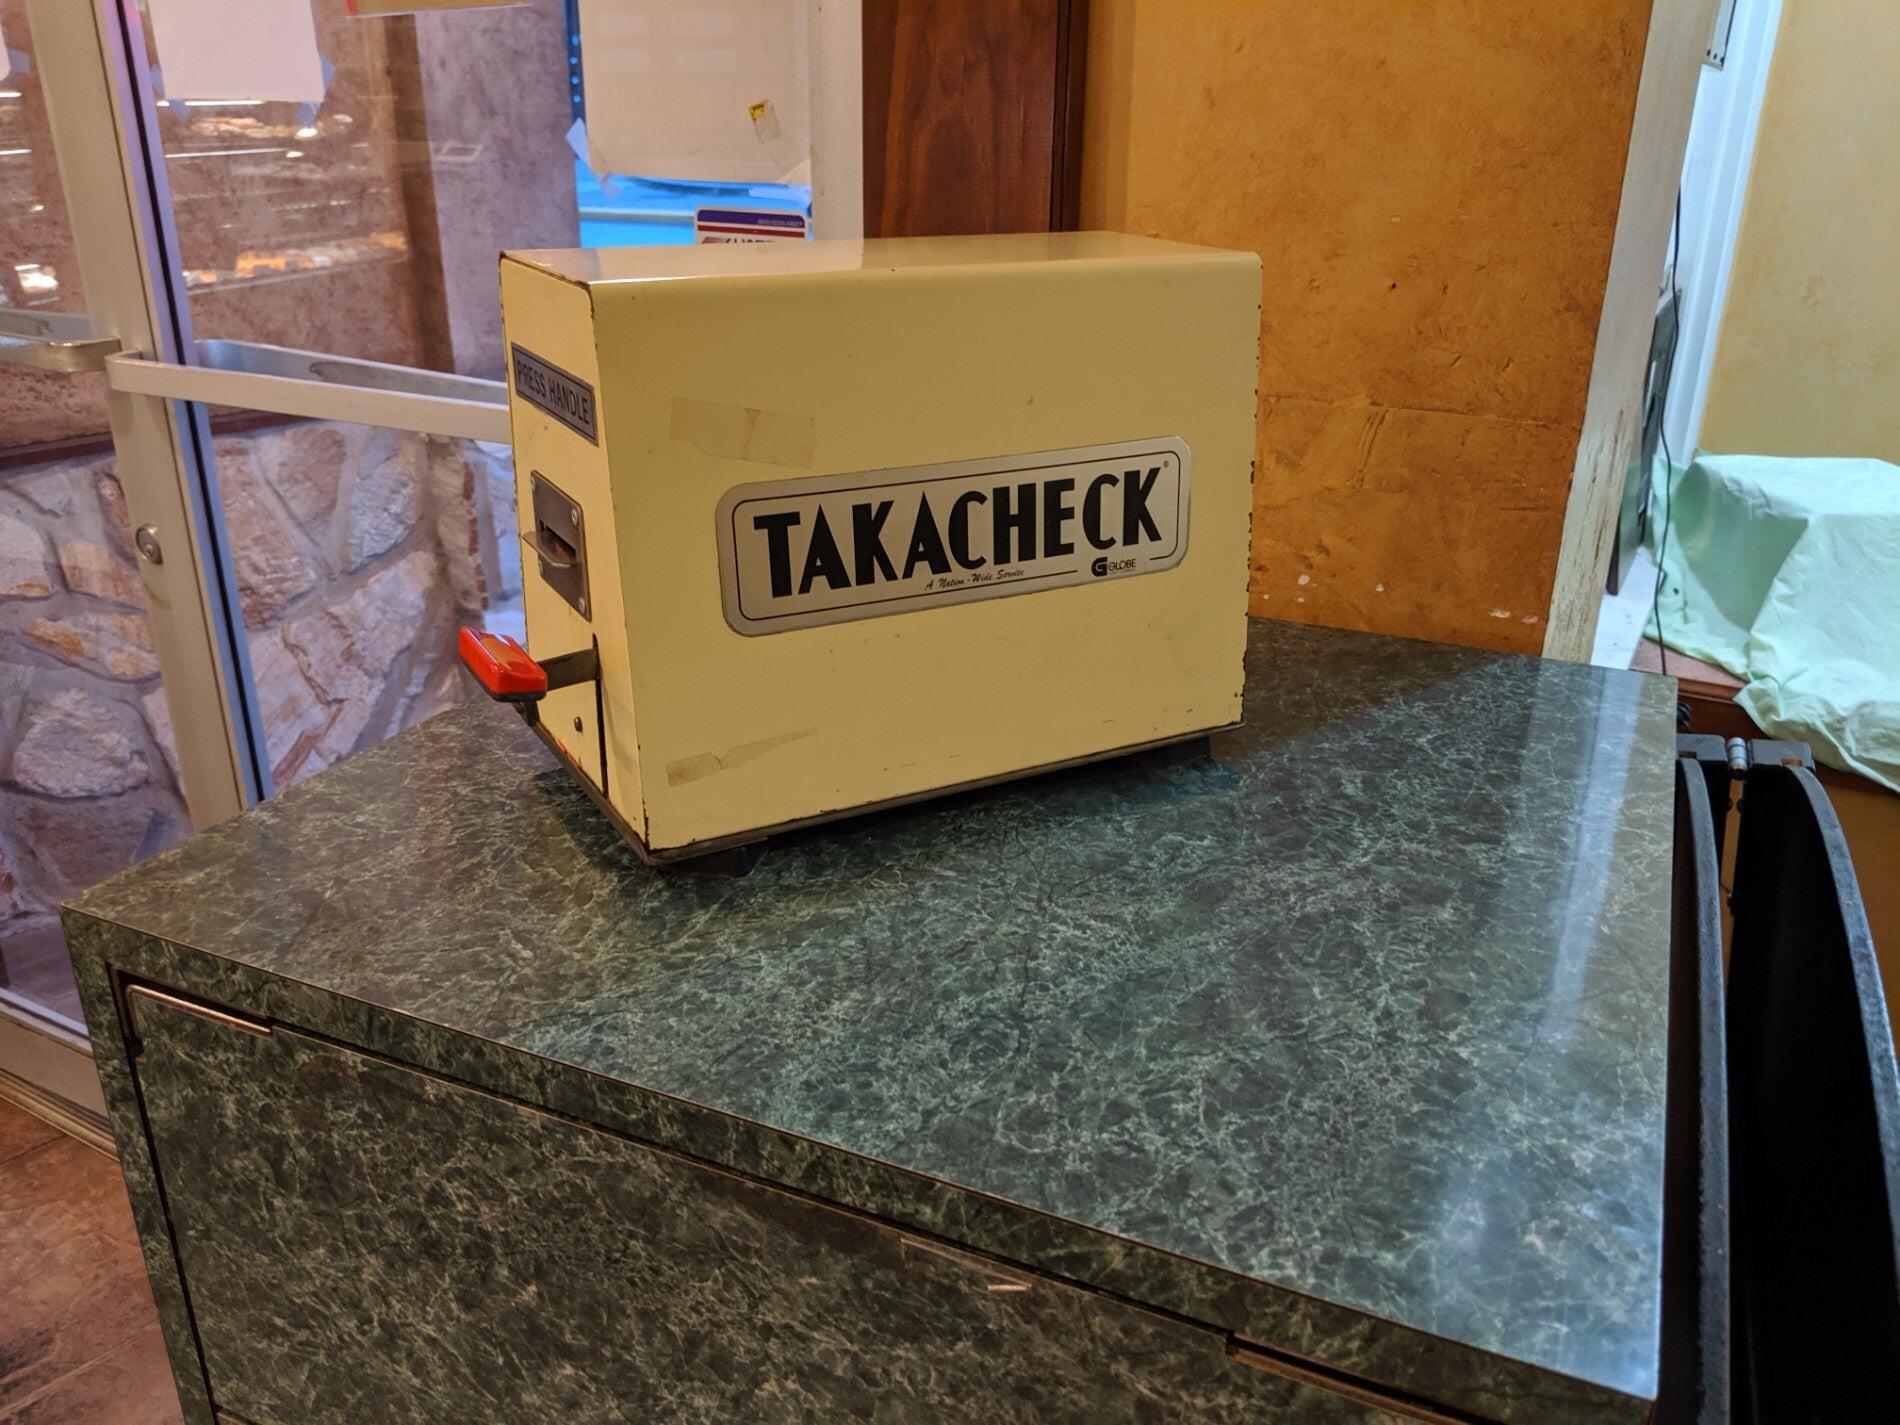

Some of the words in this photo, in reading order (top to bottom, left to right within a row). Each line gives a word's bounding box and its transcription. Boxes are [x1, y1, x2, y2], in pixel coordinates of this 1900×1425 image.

[516, 359, 547, 399] PRESS
[548, 377, 590, 426] HANDLE
[753, 466, 1163, 599] TAKACHECK
[925, 579, 934, 591] A
[996, 569, 1025, 580] Service
[1108, 558, 1137, 571] GLOBE
